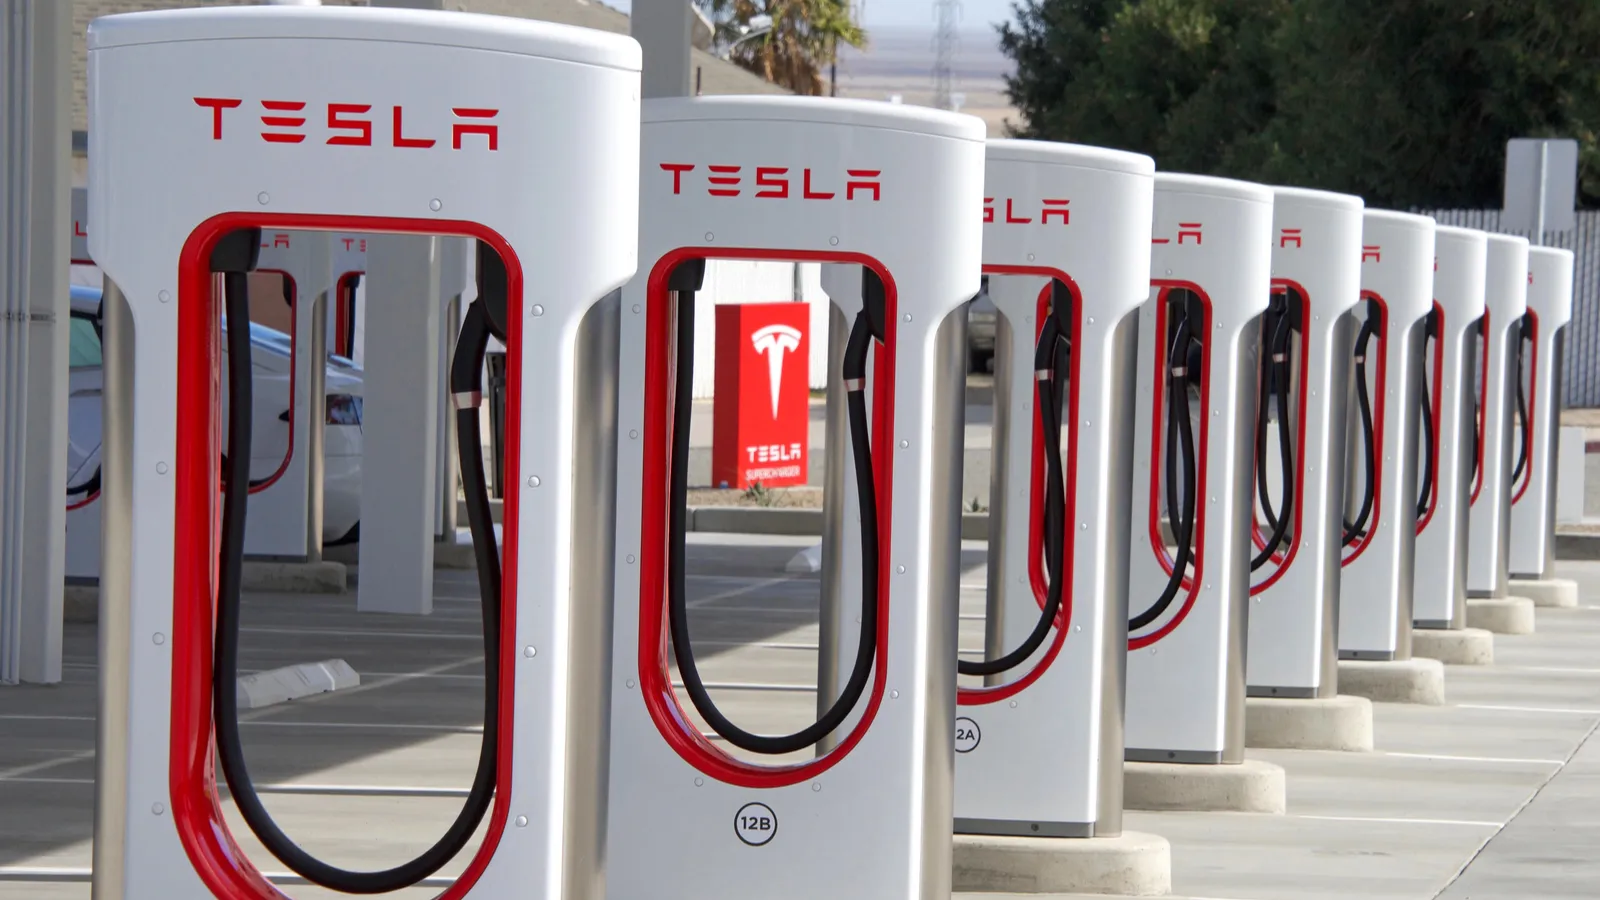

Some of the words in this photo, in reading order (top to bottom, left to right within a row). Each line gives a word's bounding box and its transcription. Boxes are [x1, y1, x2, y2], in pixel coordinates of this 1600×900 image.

[193, 97, 498, 151] TESLA
[659, 163, 881, 201] TESLA
[746, 443, 801, 463] TESLA
[740, 815, 771, 831] 12B
